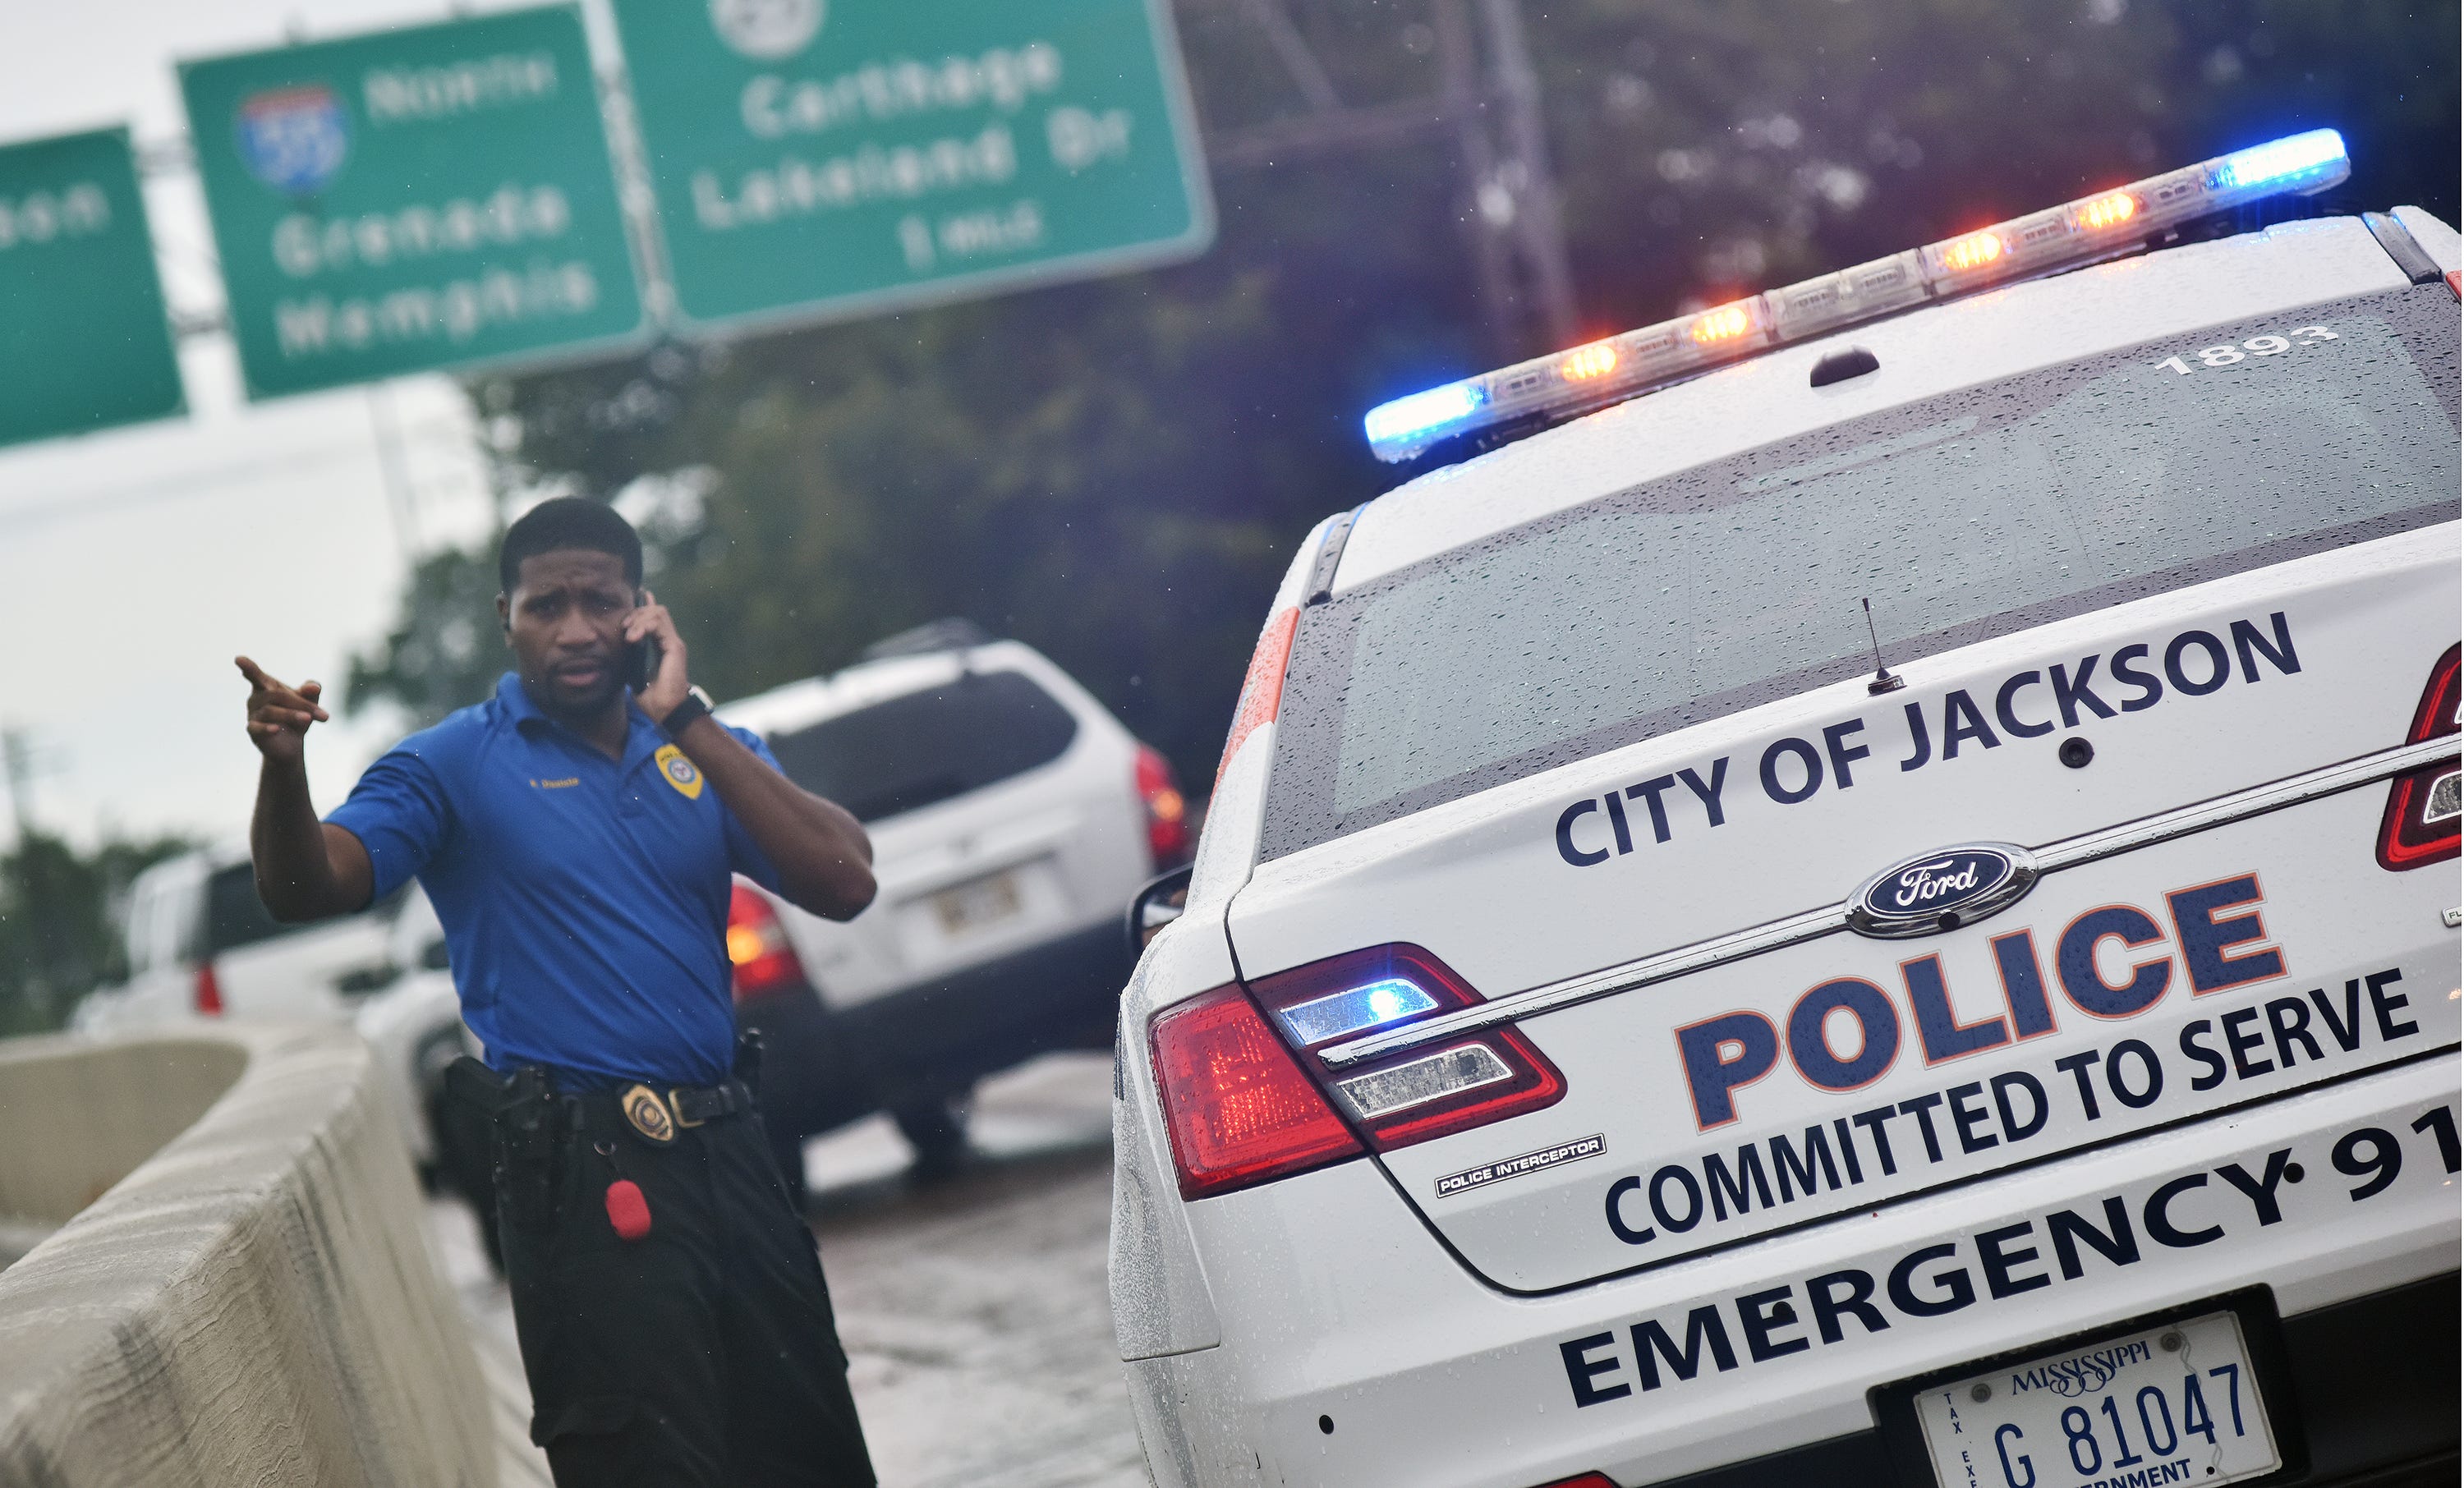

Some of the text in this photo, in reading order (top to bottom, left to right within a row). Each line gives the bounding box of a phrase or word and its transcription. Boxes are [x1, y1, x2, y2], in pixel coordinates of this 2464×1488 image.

[742, 43, 1060, 136] Carthage
[692, 105, 1131, 230] Lakeland Dr
[272, 183, 569, 277] Grenada
[899, 214, 934, 272] 1
[276, 262, 597, 358] Memphis
[2154, 325, 2339, 375] 1893
[1555, 611, 2302, 868] CITY OF JACKSON
[1895, 859, 1979, 907] Ford
[1672, 870, 2292, 1134] POLICE
[1604, 967, 2420, 1246] COMMITTED TO SERVE
[1440, 1139, 1600, 1192] POLICE INTERCEPTOR
[1559, 1146, 2293, 1409] EMERGENCY
[1943, 1392, 1964, 1435] TAX
[2011, 1339, 2153, 1398] MISSISSIPPI
[1993, 1362, 2246, 1488] G 81047
